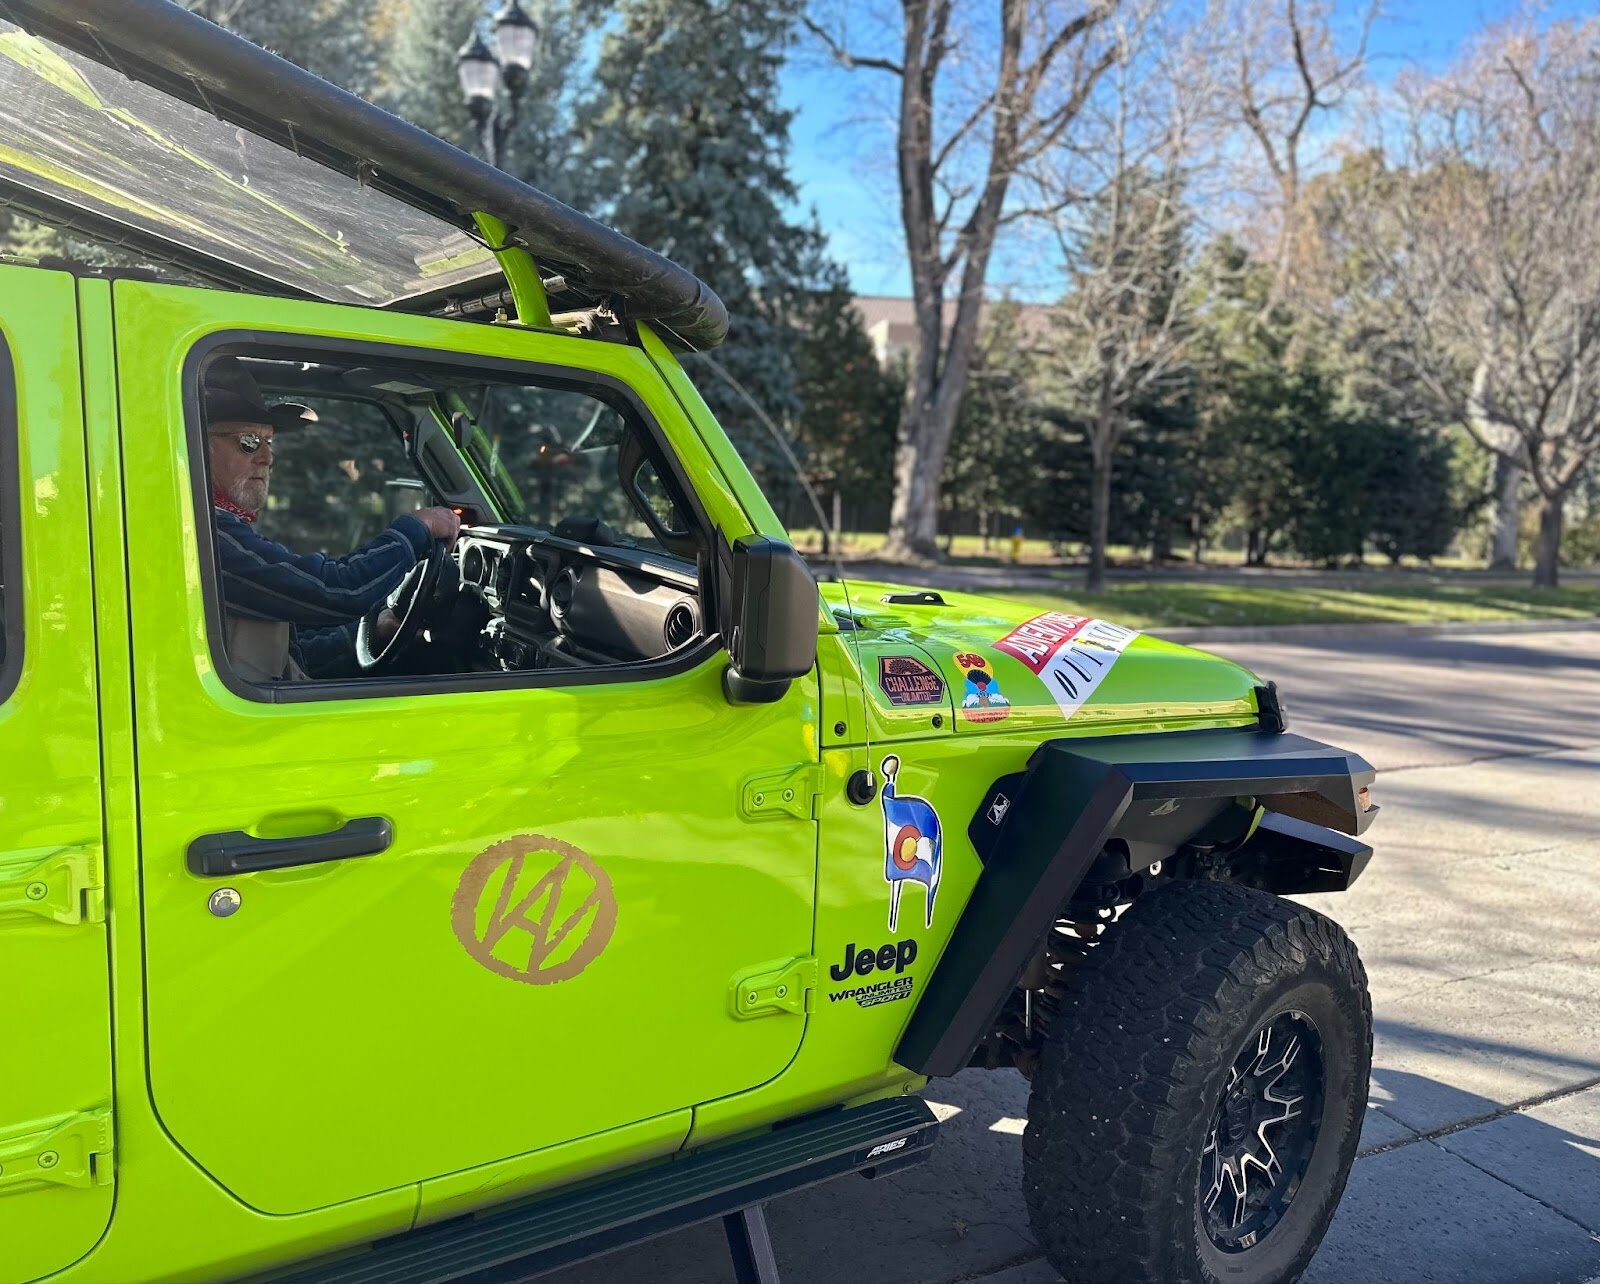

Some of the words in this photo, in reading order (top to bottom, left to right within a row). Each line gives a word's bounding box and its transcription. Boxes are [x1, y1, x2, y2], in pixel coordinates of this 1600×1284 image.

[1053, 647, 1104, 700] OUT
[884, 675, 940, 693] CHALLENGE
[900, 691, 932, 702] UNLIMITED
[830, 939, 918, 982] Jeep
[828, 976, 913, 1003] WRANGLER
[855, 984, 913, 1001] UNLIMITED
[859, 991, 911, 1007] SPORT
[866, 1137, 908, 1158] ARIES
